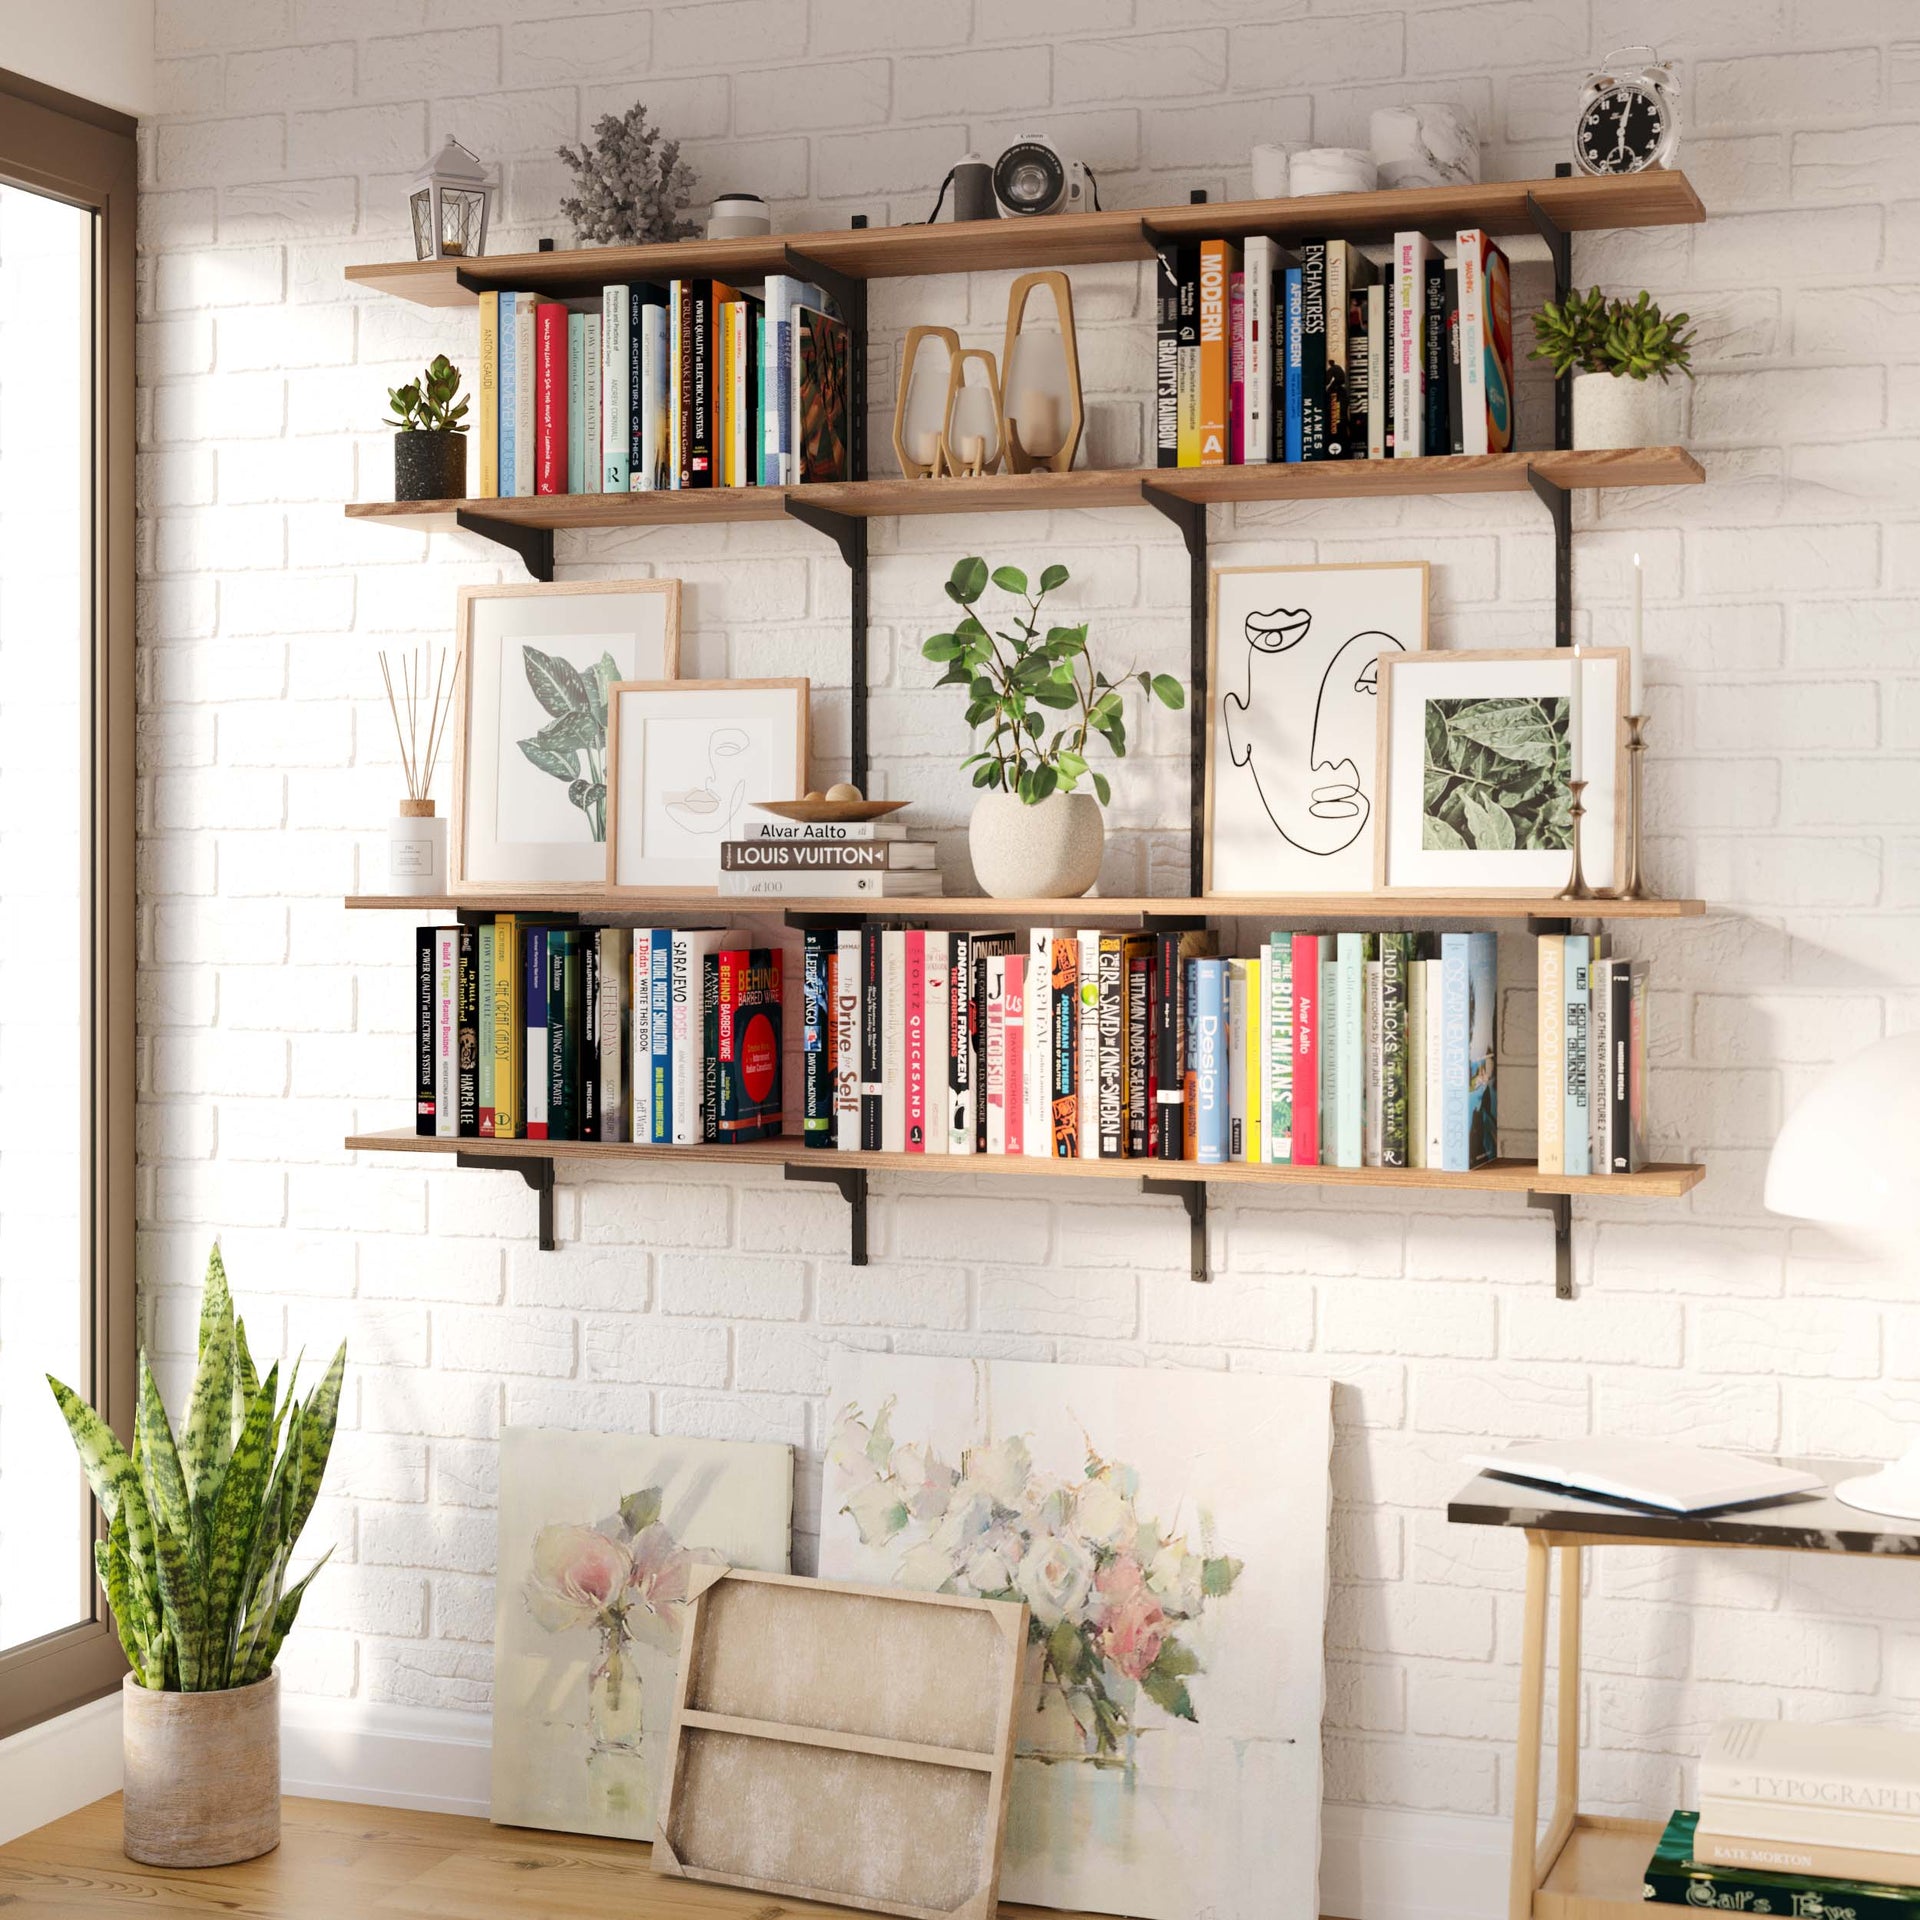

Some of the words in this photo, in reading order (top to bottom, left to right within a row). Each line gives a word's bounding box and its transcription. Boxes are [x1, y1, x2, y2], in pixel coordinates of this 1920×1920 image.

[1601, 100, 1610, 111] 11
[1617, 92, 1630, 103] 12
[1636, 94, 1643, 104] 1
[1647, 105, 1657, 116] 2
[1587, 114, 1600, 126] 10
[1651, 122, 1661, 134] 3
[1583, 131, 1593, 143] 9
[1588, 148, 1599, 160] 8
[1200, 253, 1224, 342] MODERN
[1290, 283, 1302, 315] AFRO
[1305, 244, 1325, 335] ENCHANTRESS
[1427, 278, 1441, 310] Digital
[695, 300, 704, 323] POWER
[502, 313, 515, 357] OSCAR
[587, 324, 596, 347] HOW
[694, 323, 704, 356] QUALITY
[1290, 316, 1302, 368] MODERN
[1427, 314, 1441, 380] Entanglement
[587, 350, 596, 377] THEY
[1158, 338, 1178, 396] GRAVITY'S
[502, 358, 515, 427] NIEMEYER
[695, 363, 704, 406] ELECTRICAL
[587, 380, 596, 442] DECORATED
[695, 407, 704, 439] SYSTEMS
[1158, 398, 1178, 450] RAINBOW
[1202, 435, 1224, 454] A
[1303, 398, 1312, 461] MAXWELL
[1313, 407, 1323, 450] JAMES
[502, 429, 515, 482] HOUSES
[760, 824, 800, 838] Alvar
[803, 824, 847, 838] Aalto
[737, 846, 789, 865] LOUIS
[792, 846, 874, 865] VUITTON
[422, 948, 432, 972] POWER
[442, 941, 452, 960] Build
[483, 936, 492, 957] HOW
[553, 954, 563, 968] John
[639, 944, 649, 976] Didn't
[442, 960, 452, 968] A
[483, 960, 492, 971] TO
[652, 949, 668, 981] VIRTUAL
[673, 941, 688, 1003] SARAJEVO
[738, 967, 780, 992] BEHIND
[805, 953, 819, 985] LEPER
[950, 967, 958, 986] THE
[957, 940, 967, 1012] JONATHAN
[1100, 953, 1120, 984] GIRL
[1383, 948, 1399, 996] INDIA
[1577, 966, 1588, 991] LE
[421, 972, 432, 1004] QUALITY
[440, 975, 452, 998] Figure
[459, 957, 468, 1022] Mockingbird
[483, 973, 492, 994] LIVE
[602, 976, 618, 1017] AFTER
[639, 978, 649, 1006] WRITE
[652, 981, 668, 1011] PATIENT
[704, 961, 713, 1017] MAXWELL
[720, 965, 731, 1003] BEHIND
[738, 990, 763, 1007] BARBED
[763, 988, 781, 1003] WIRE
[843, 977, 853, 993] The
[912, 959, 920, 1009] TOLTZ
[988, 973, 1004, 1000] J
[1130, 973, 1145, 1020] HITMAN
[1327, 972, 1337, 998] HOW
[1448, 958, 1465, 1014] OSCAR
[440, 999, 452, 1025] Beauty
[483, 995, 492, 1019] WELL
[639, 1007, 649, 1027] THIS
[805, 985, 820, 1025] TANGO
[1005, 994, 1023, 1012] Us
[1036, 965, 1048, 1048] CAPITAL
[1100, 994, 1121, 1037] SAVED
[1299, 996, 1311, 1024] Alvar
[1327, 999, 1337, 1031] THEY
[1370, 972, 1380, 1032] Watercolors
[1543, 950, 1560, 1056] HOLLYWOOD
[1567, 1003, 1578, 1026] LE
[422, 1011, 432, 1053] ELECTRICAL
[652, 1011, 668, 1056] SIMULATION
[673, 1004, 688, 1041] ROSES
[720, 1003, 731, 1037] BARBED
[839, 995, 858, 1053] Drive
[950, 987, 958, 1058] CORRECTIONS
[1061, 993, 1070, 1049] JONATHAN
[1383, 999, 1399, 1053] HICKS
[442, 1025, 452, 1057] Business
[602, 1022, 618, 1056] DAYS
[639, 1028, 649, 1053] BOOK
[720, 1038, 731, 1060] WIRE
[957, 1015, 967, 1084] FRANZEN
[1010, 1033, 1018, 1065] DAVID
[1055, 1049, 1062, 1058] OF
[1130, 1022, 1145, 1066] ANDERS
[1271, 981, 1293, 1104] BOHEMIANS
[1299, 1025, 1311, 1055] Aalto
[1369, 1032, 1380, 1044] by
[1448, 1014, 1465, 1088] NIEMEYER
[422, 1053, 432, 1085] SYSTEMS
[806, 1052, 816, 1075] DAVID
[842, 1054, 854, 1069] for
[910, 1015, 921, 1118] QUICKSAND
[1100, 1046, 1121, 1078] KING
[1198, 1015, 1218, 1110] Design
[1327, 1034, 1337, 1101] DECORATED
[1371, 1046, 1380, 1067] Finn
[1567, 1037, 1578, 1096] GRAND
[1577, 1003, 1588, 1108] CORBUSIER
[1061, 1052, 1070, 1095] LETHEM
[1371, 1068, 1380, 1088] Juhl
[1386, 1060, 1397, 1099] ISLAND
[460, 1073, 475, 1107] HARPER
[607, 1079, 616, 1101] SCOTT
[634, 1098, 647, 1114] Jeff
[706, 1057, 717, 1138] ENCHANTRESS
[806, 1075, 816, 1117] MacKINNON
[839, 1071, 859, 1113] Self
[1010, 1068, 1018, 1125] NICHOLLS
[1130, 1067, 1145, 1119] MEANING
[1188, 1080, 1197, 1104] MARK
[1543, 1060, 1559, 1144] INTERIORS
[460, 1108, 474, 1125] LEE
[606, 1101, 617, 1136] MEDBURY
[637, 1114, 647, 1137] Watts
[1100, 1084, 1121, 1135] SWEDEN
[1188, 1104, 1197, 1138] WATSON
[1386, 1102, 1396, 1133] STYLE
[1447, 1089, 1465, 1150] HOUSES
[1713, 1846, 1749, 1860] KATE
[1750, 1849, 1813, 1867] MORTON
